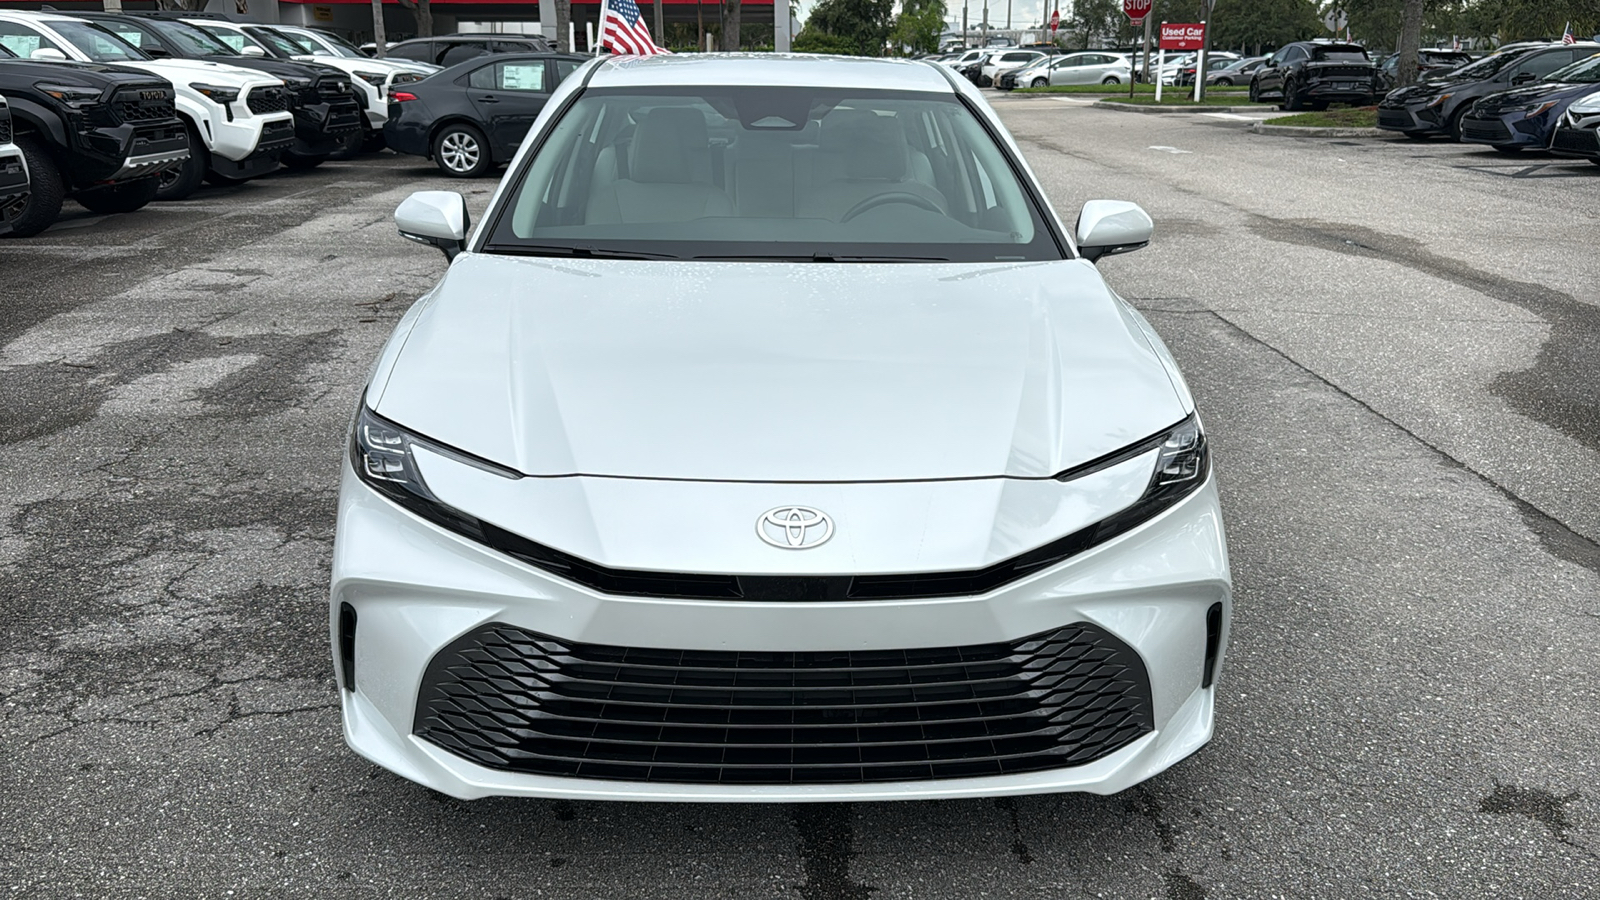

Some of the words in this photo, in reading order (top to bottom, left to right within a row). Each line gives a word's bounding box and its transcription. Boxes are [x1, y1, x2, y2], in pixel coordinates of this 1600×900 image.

[1125, 0, 1150, 10] STOP
[1162, 27, 1185, 36] Used
[1186, 27, 1203, 36] Car
